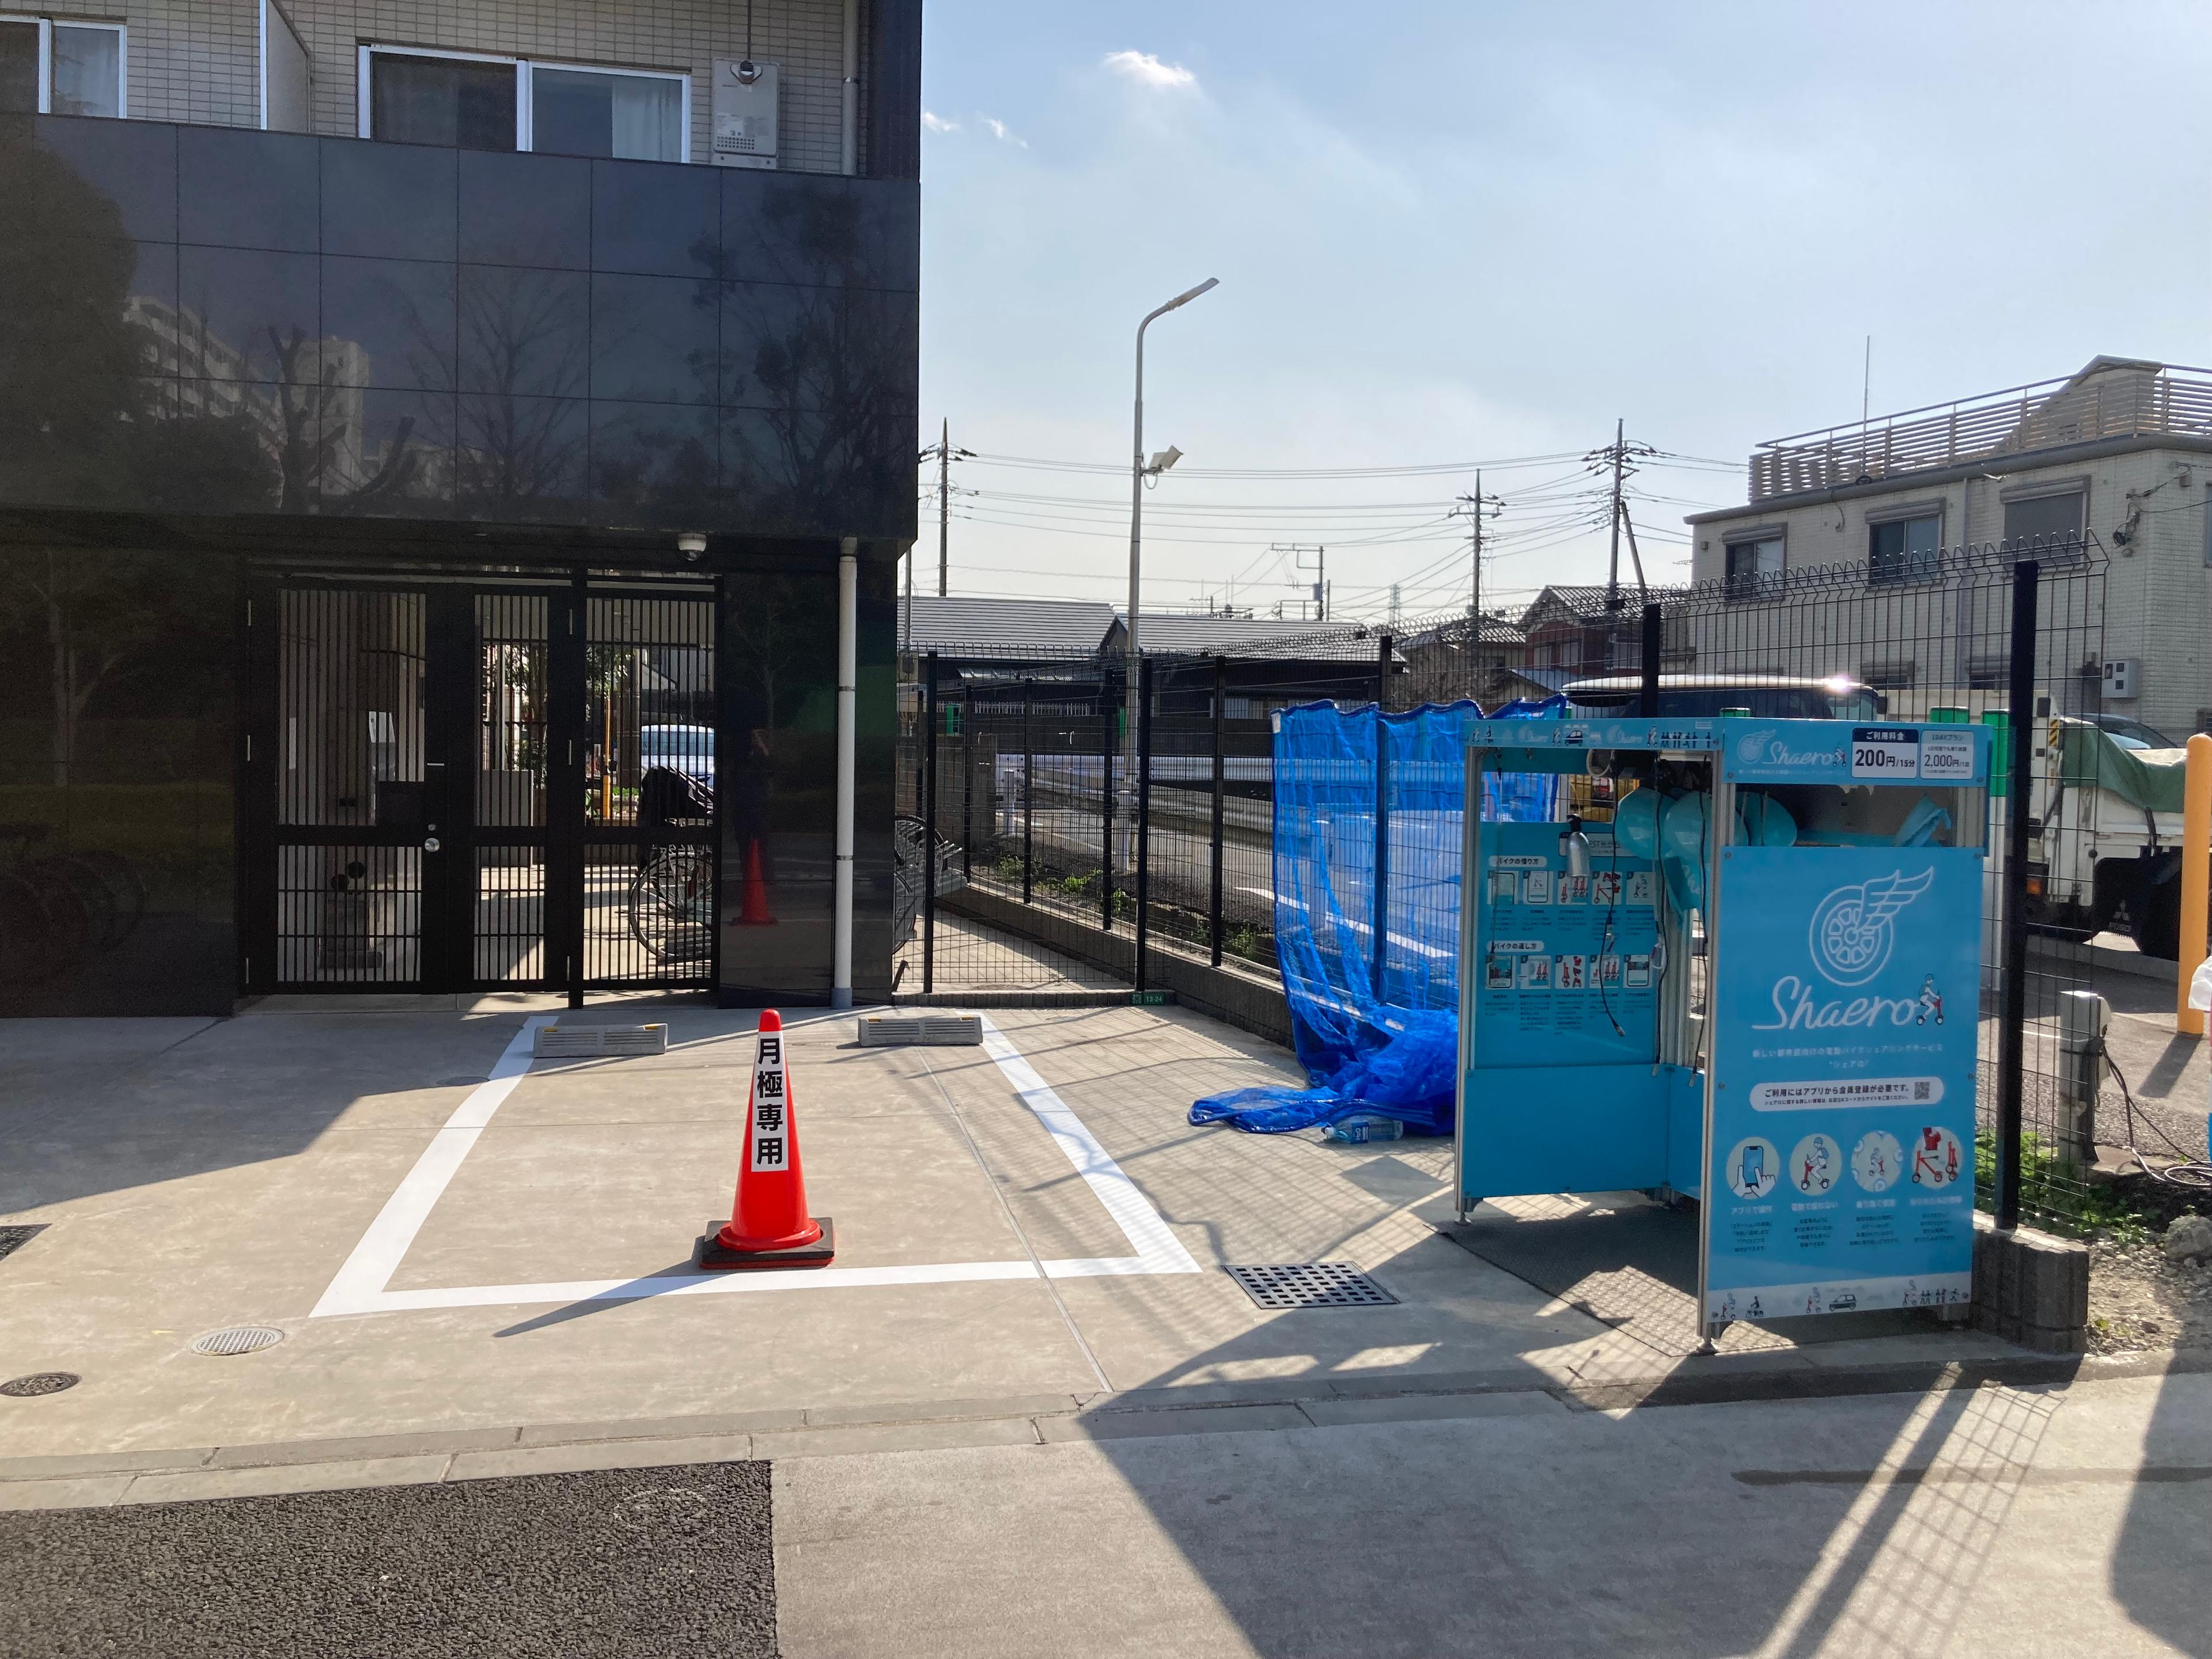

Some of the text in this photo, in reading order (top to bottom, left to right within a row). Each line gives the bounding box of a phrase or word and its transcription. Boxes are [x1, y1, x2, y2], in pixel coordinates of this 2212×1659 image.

[1866, 731, 1904, 741] ご利用料金
[1762, 741, 1836, 766] Shaero
[1752, 975, 1921, 1030] Shaero
[756, 1037, 783, 1165] 月極専用
[1765, 1084, 1909, 1097] ご利用にはアプリから会員登録が必要です。
